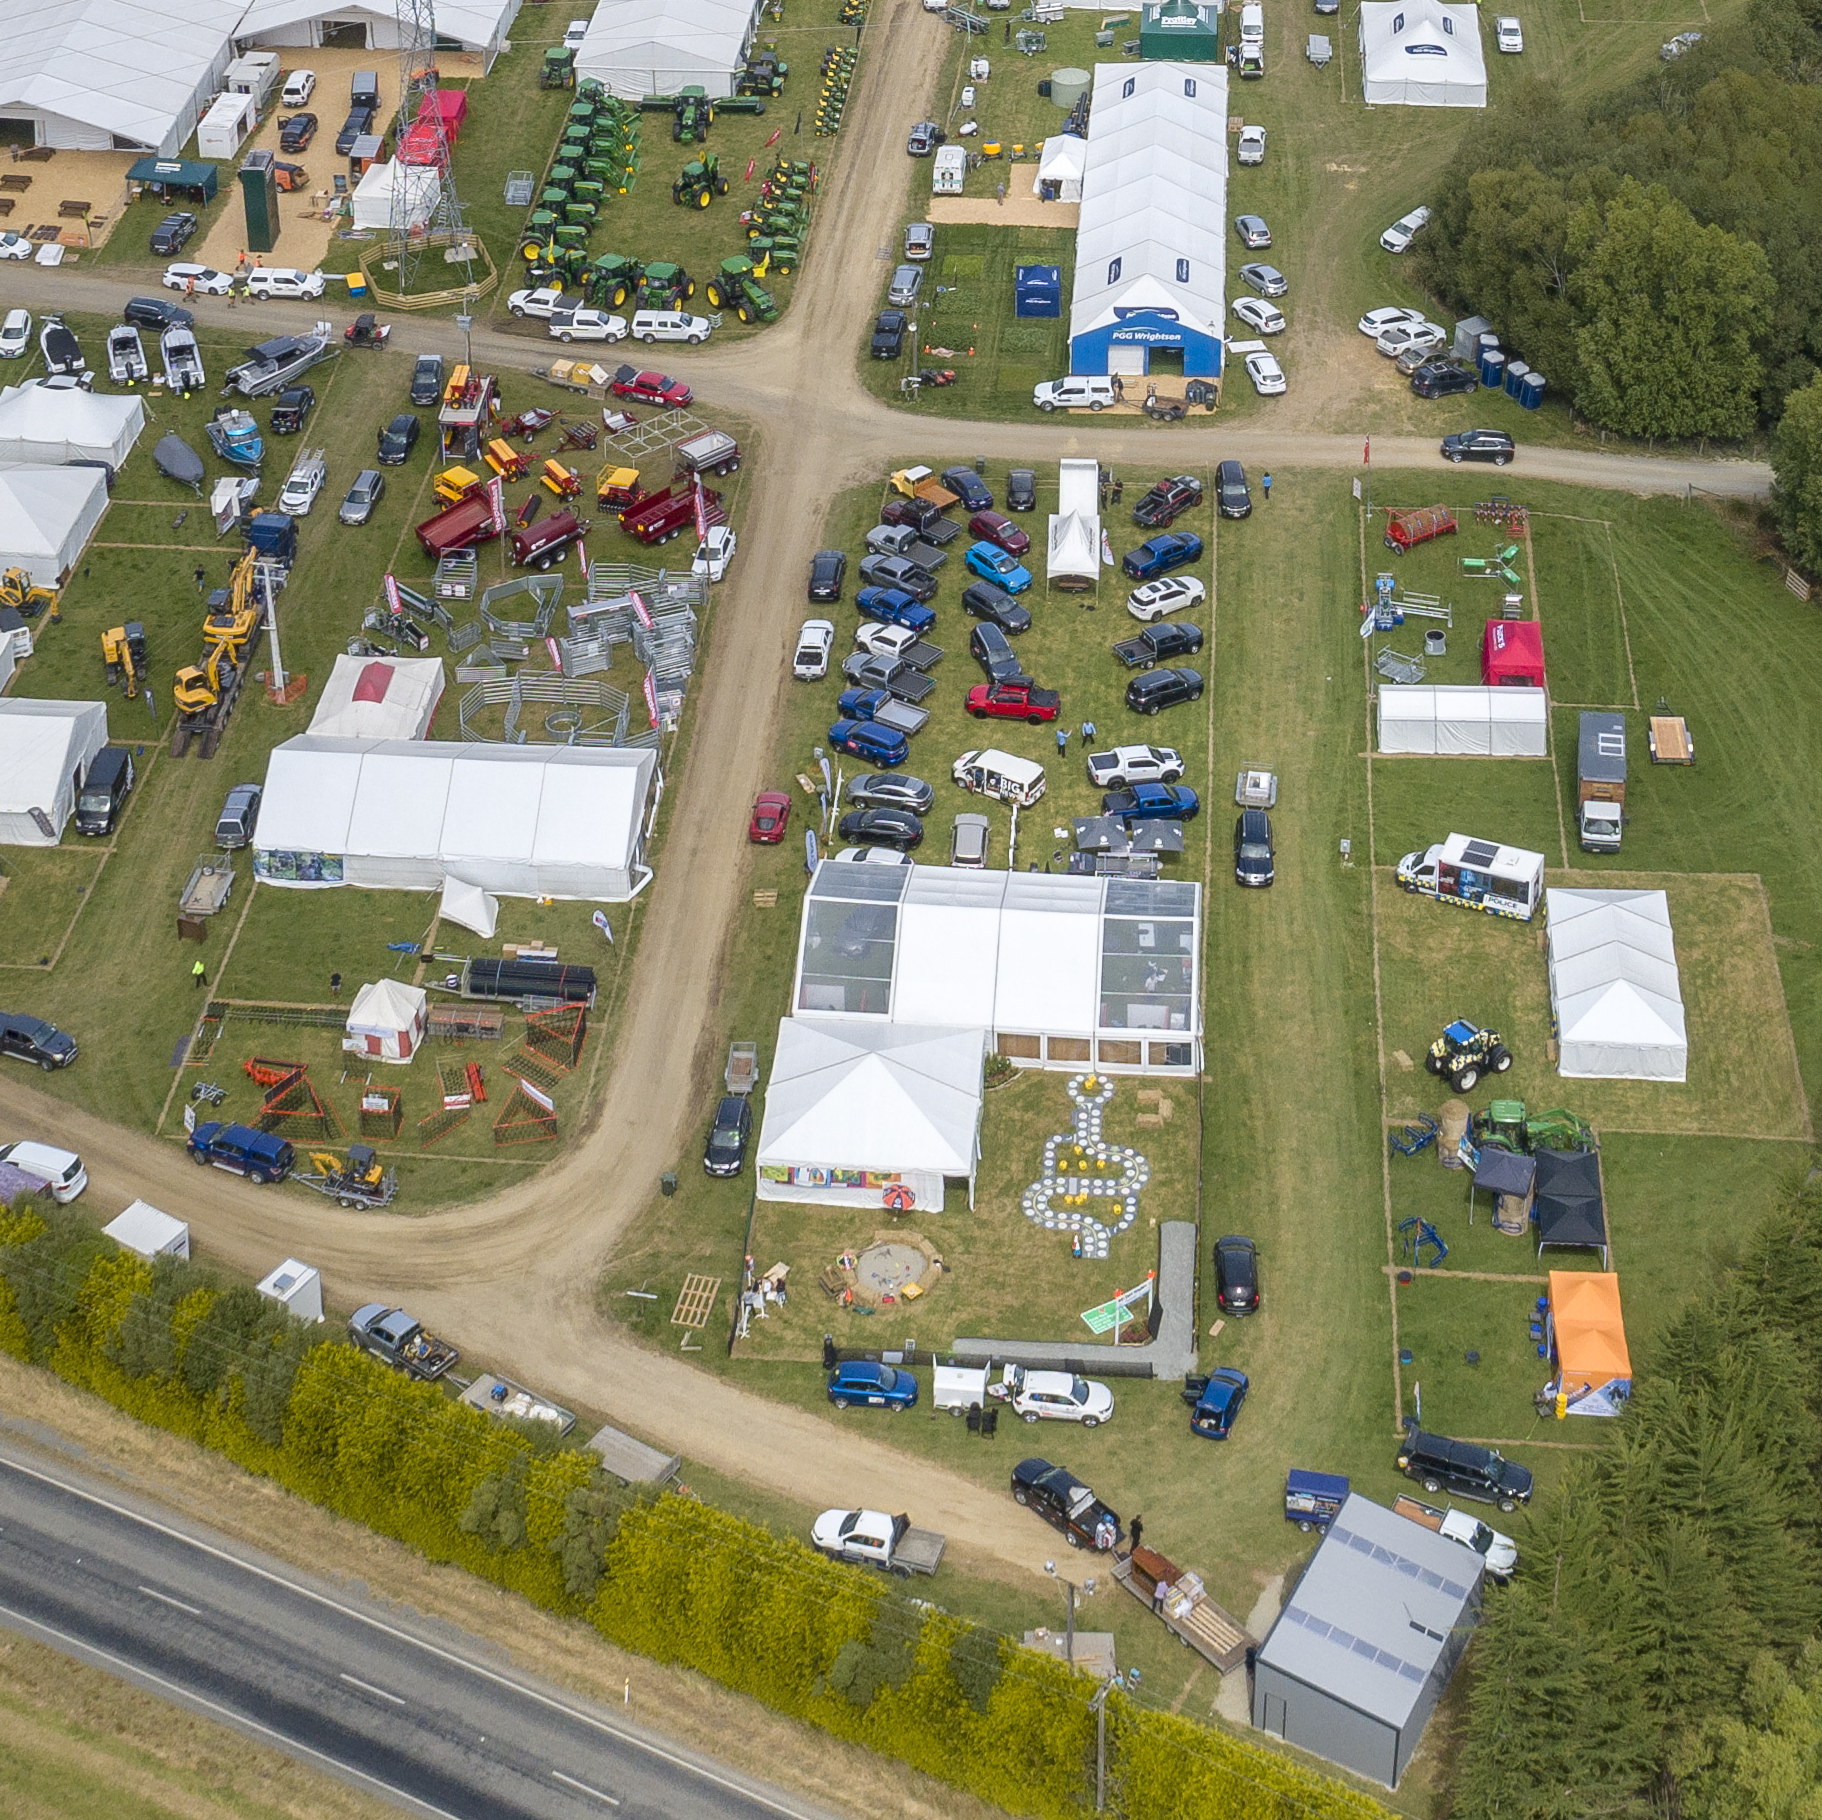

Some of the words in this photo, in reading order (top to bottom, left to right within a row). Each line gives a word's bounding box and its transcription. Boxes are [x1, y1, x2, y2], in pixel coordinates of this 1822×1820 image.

[1112, 332, 1134, 340] PGG
[1134, 332, 1181, 342] Wrightson
[1001, 778, 1021, 794] BIG
[1487, 895, 1518, 908] POLICE
